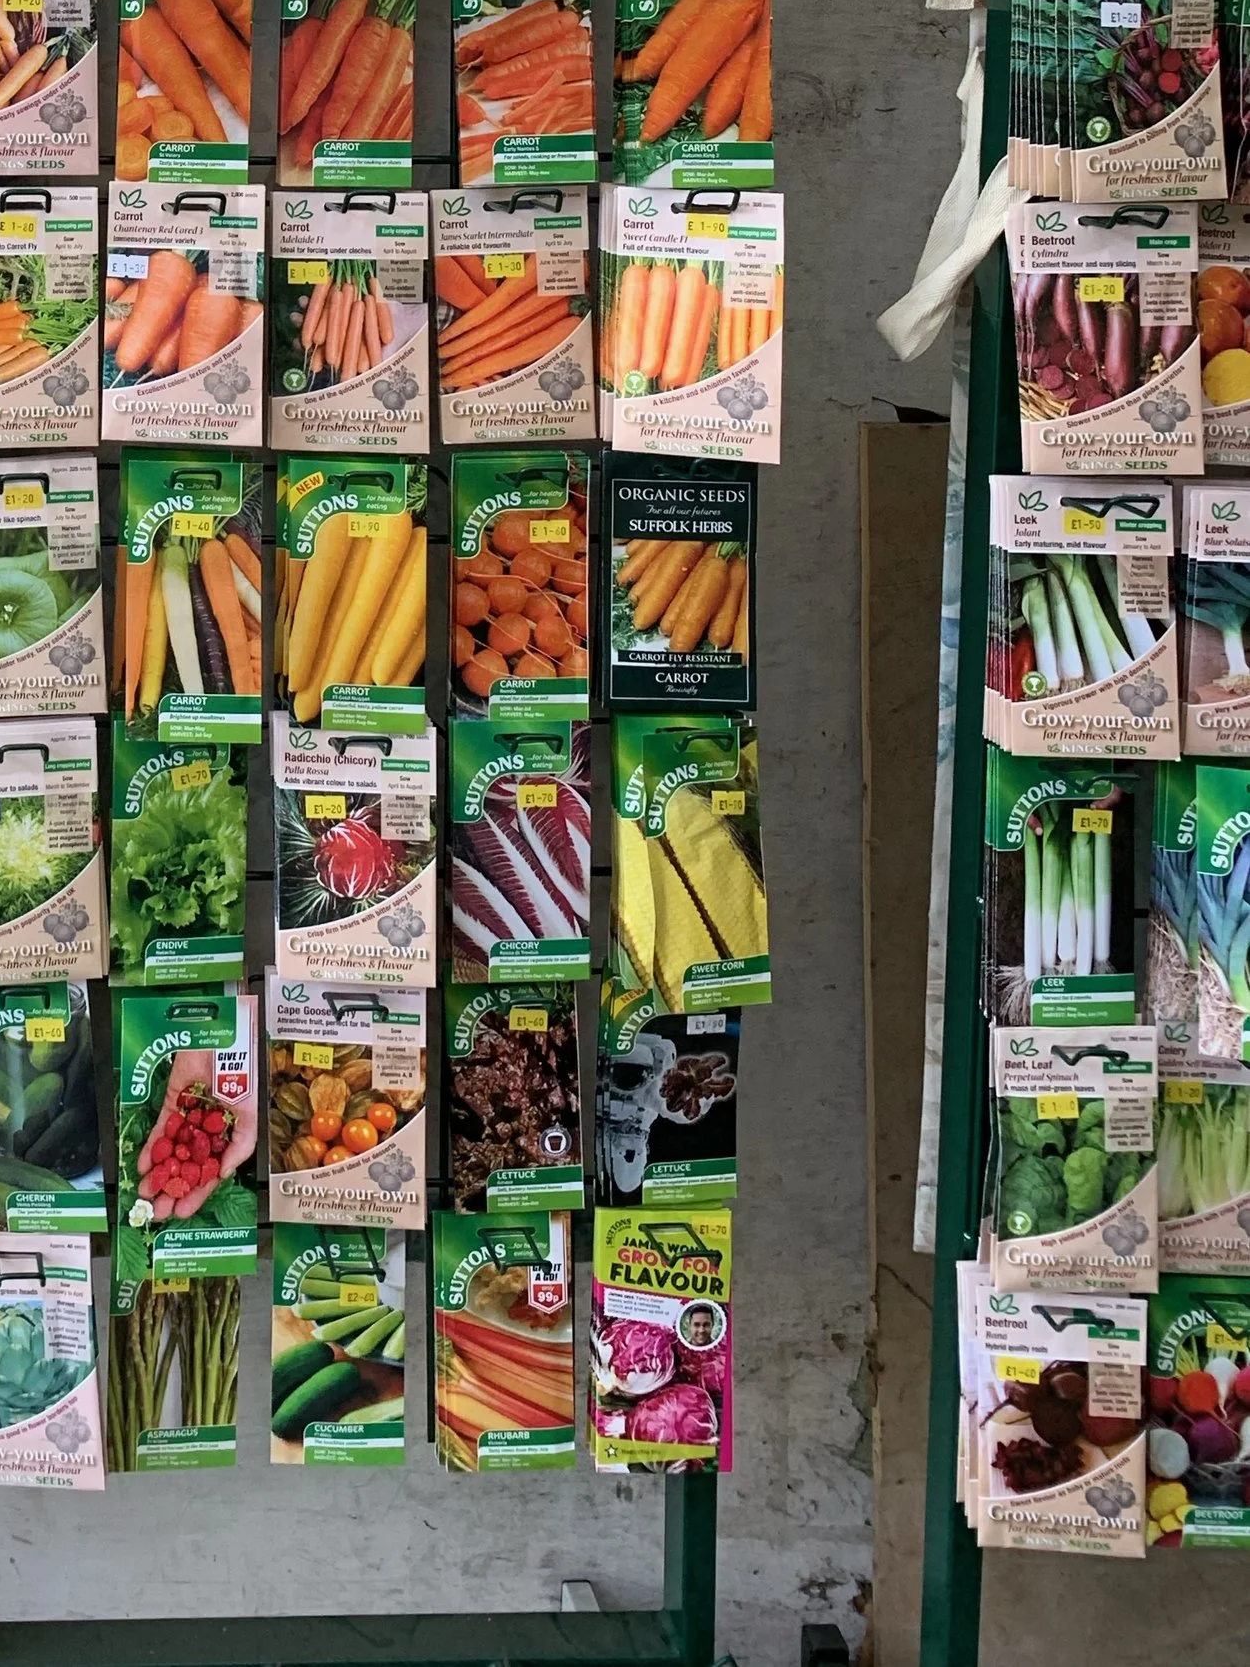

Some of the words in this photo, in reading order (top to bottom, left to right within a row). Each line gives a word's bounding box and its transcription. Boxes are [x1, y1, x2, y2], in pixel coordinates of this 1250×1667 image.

[159, 143, 196, 153] CARROT
[681, 143, 718, 153] CARROT
[439, 219, 468, 229] Carrot
[1032, 234, 1075, 246] Beetroot
[1032, 249, 1069, 260] Cylindra
[296, 475, 322, 494] NEW
[1014, 515, 1037, 525] Leek
[1015, 529, 1040, 538] Jolant
[629, 653, 666, 662] CARROT
[669, 654, 685, 662] FLY
[687, 654, 732, 663] RESISTANT
[500, 680, 535, 688] CARROT
[170, 696, 207, 705] CARROT
[1022, 708, 1170, 731] Grow-your-own
[285, 753, 331, 765] Radicchio
[334, 756, 376, 767] (Chicory)
[1007, 779, 1066, 843] SUTTONS
[156, 941, 188, 949] ENDIVE
[500, 941, 539, 949] CHICORY
[691, 963, 717, 975] SWEET
[720, 962, 744, 970] CORN
[1043, 978, 1065, 986] LEEK
[277, 1005, 298, 1015] Cape
[1004, 1061, 1031, 1072] Beet,
[1034, 1061, 1052, 1071] Leaf
[497, 1171, 536, 1179] LETTUCE
[16, 1194, 55, 1203] GHERKIN
[164, 1231, 189, 1241] ALPINE
[191, 1229, 249, 1240] STRAWBERRY
[610, 1265, 724, 1296] FLAVOUR
[985, 1318, 1027, 1329] Beetroot
[147, 1428, 198, 1438] ASPARAGUS
[488, 1431, 530, 1440] RHUBARB
